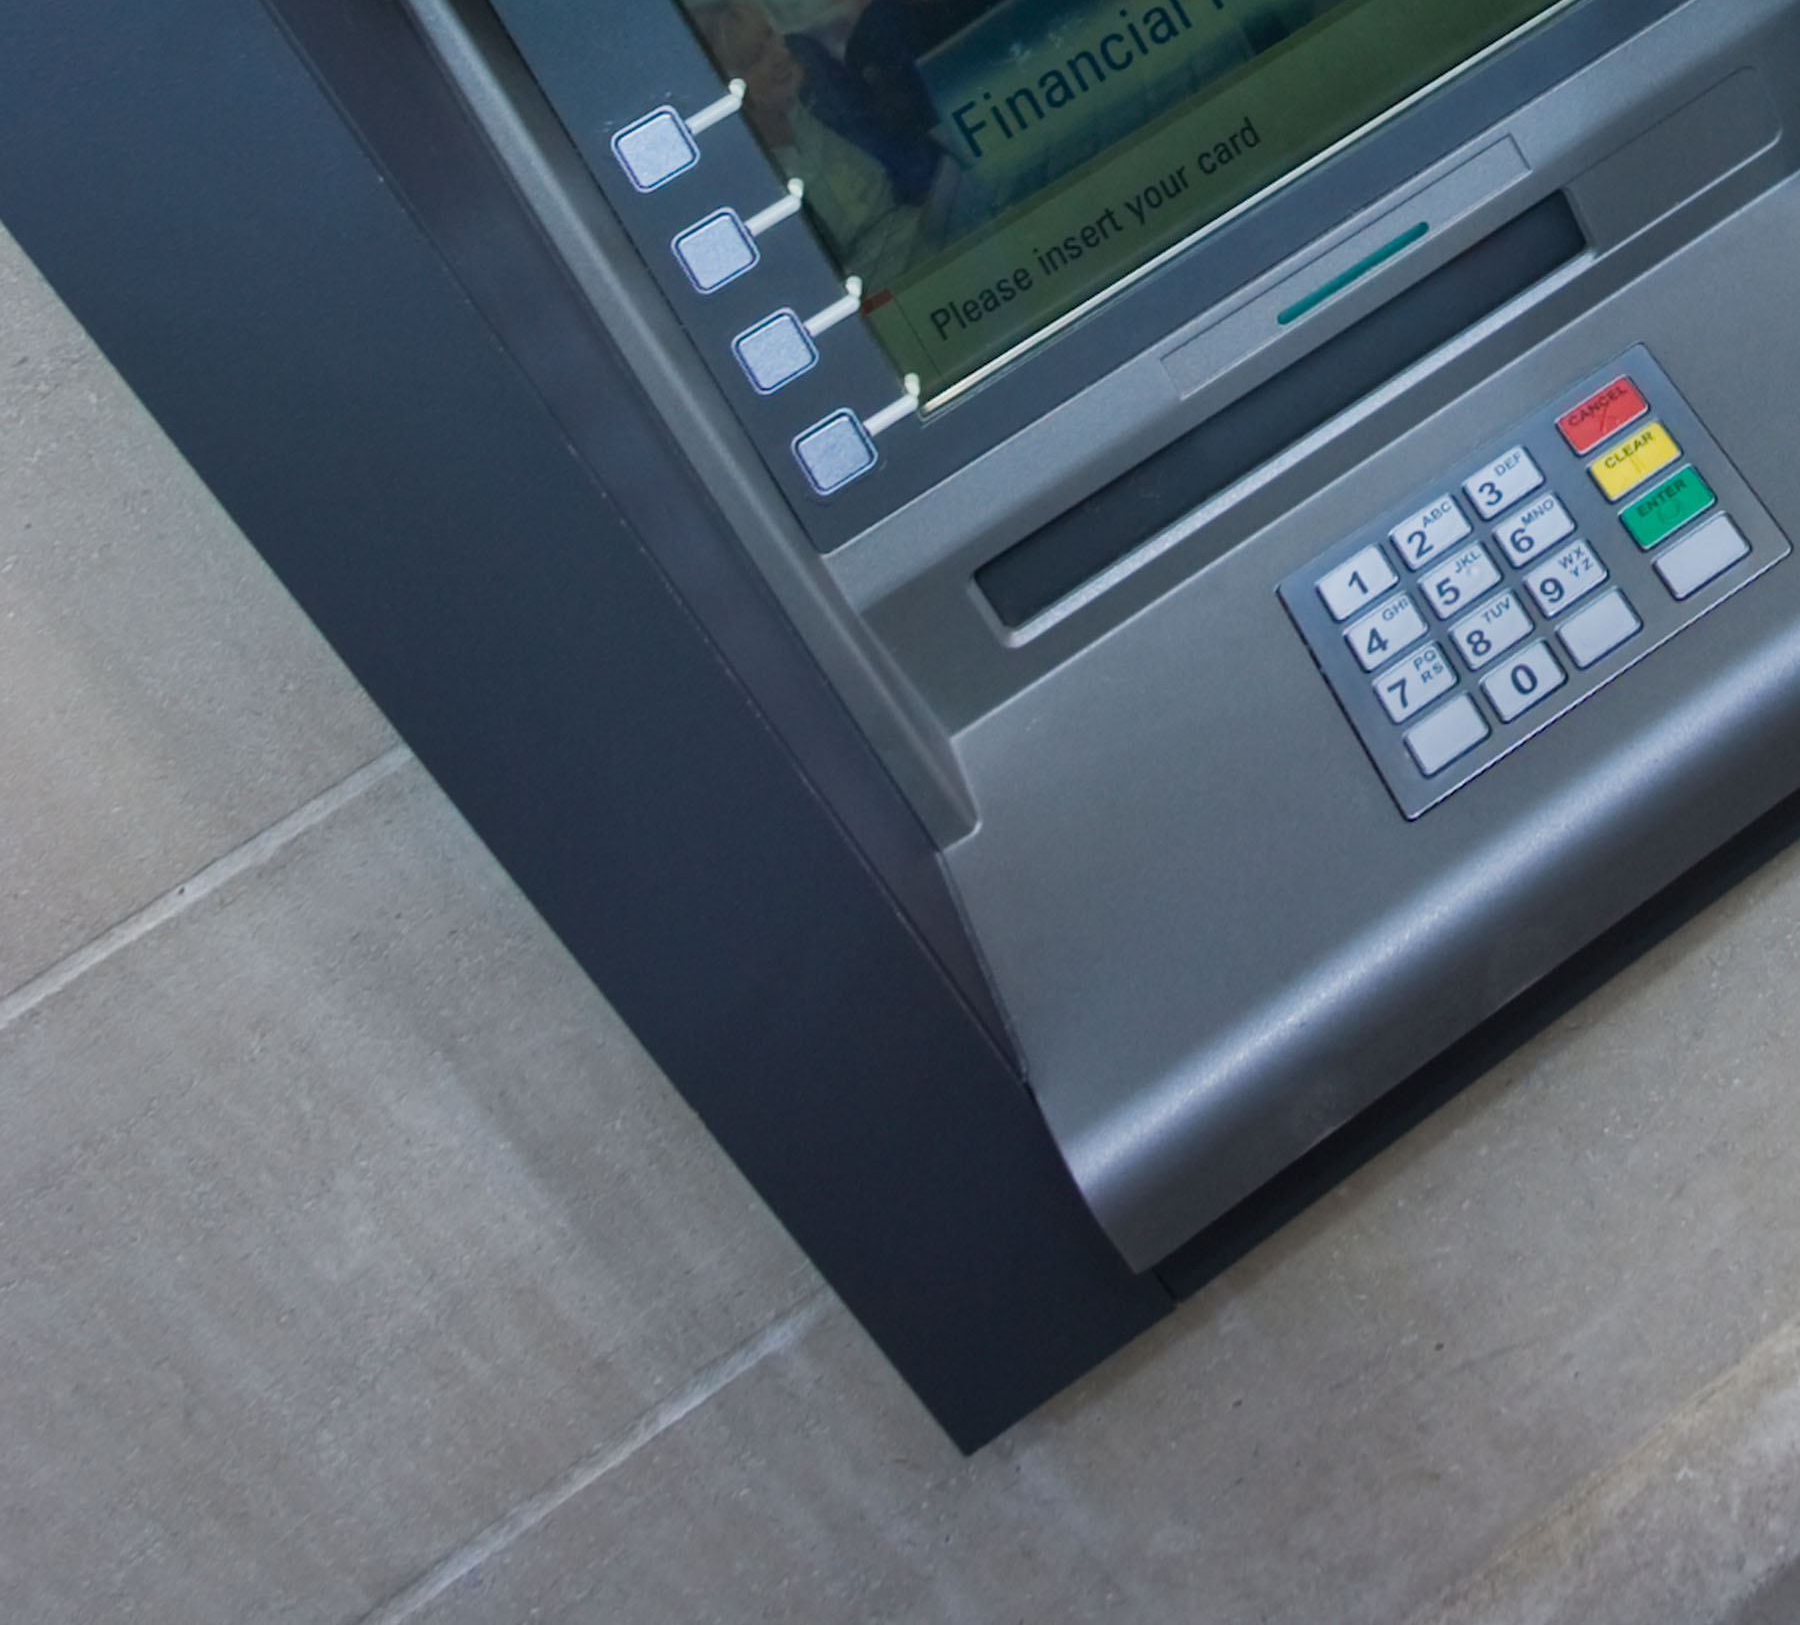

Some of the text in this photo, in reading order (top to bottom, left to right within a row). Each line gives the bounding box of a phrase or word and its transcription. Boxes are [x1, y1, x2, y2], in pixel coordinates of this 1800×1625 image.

[929, 115, 1262, 342] Please insert your card
[1568, 385, 1628, 427] CANCEL
[1604, 430, 1654, 469] CLEAR
[1478, 451, 1523, 507] 3 DEF
[1635, 478, 1687, 518] ENTER
[1407, 501, 1452, 559] 2 ABC
[1510, 499, 1555, 554] 6 MNO
[1348, 570, 1369, 595] 1
[1435, 550, 1482, 606] 5 JKL
[1539, 577, 1565, 605] 9
[1367, 597, 1409, 655] 4 GHI
[1465, 597, 1511, 657] 8 TUV
[1386, 678, 1409, 709] 7
[1511, 664, 1538, 695] 0
